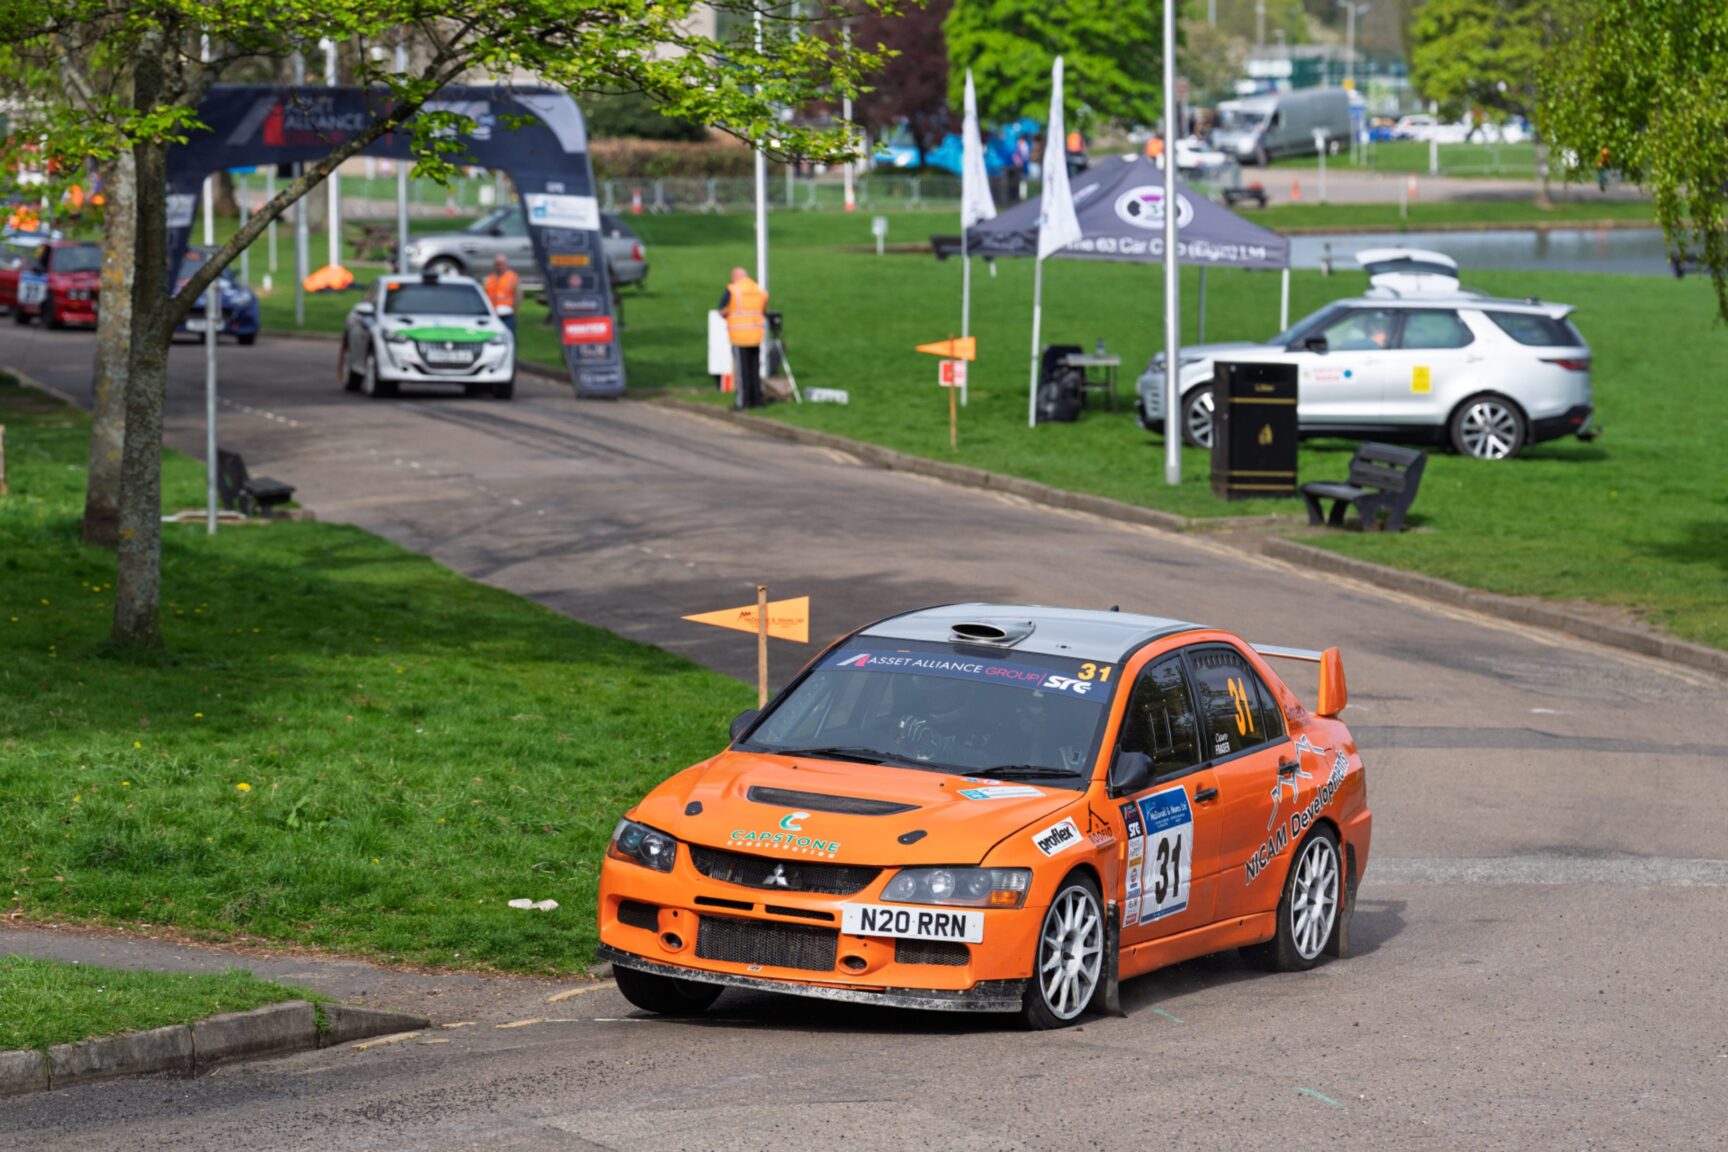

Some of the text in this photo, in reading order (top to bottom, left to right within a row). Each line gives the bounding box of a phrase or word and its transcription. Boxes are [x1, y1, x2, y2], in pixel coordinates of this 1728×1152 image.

[867, 656, 1040, 681] ASSET ALLIANCE GROUP
[1077, 662, 1112, 682] 31
[1227, 677, 1255, 736] 31
[1244, 822, 1289, 886] NICAM
[1290, 750, 1349, 840] Developments
[731, 829, 841, 853] CAPSTONE
[1038, 826, 1073, 855] proflex
[1155, 834, 1181, 904] 31
[860, 907, 967, 937] N20 RRN
